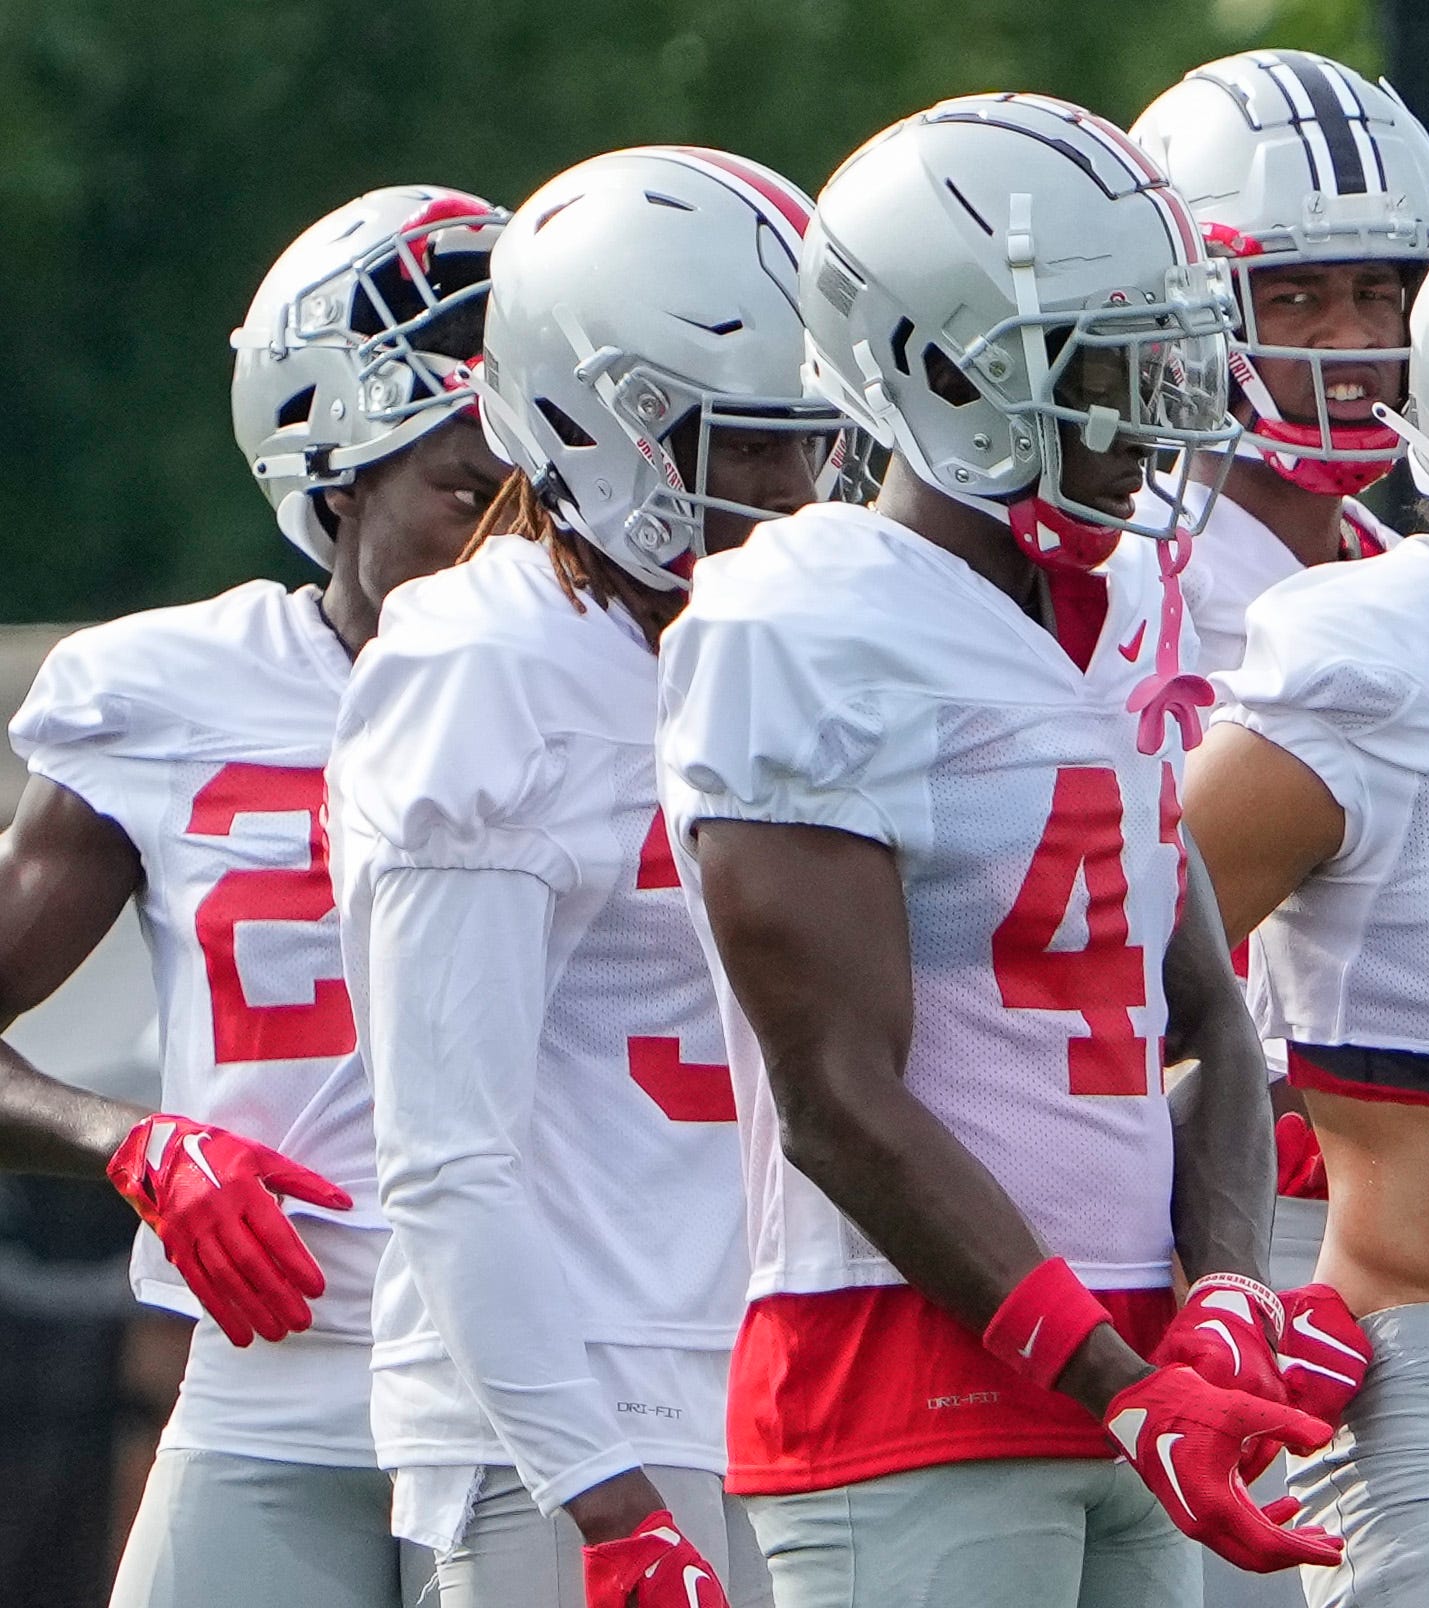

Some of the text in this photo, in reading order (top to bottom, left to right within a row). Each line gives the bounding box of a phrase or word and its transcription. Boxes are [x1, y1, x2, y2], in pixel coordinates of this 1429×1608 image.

[992, 765, 1188, 1097] 4
[926, 1391, 1001, 1410] DRI-FIT
[617, 1401, 682, 1420] DRI-FIT
